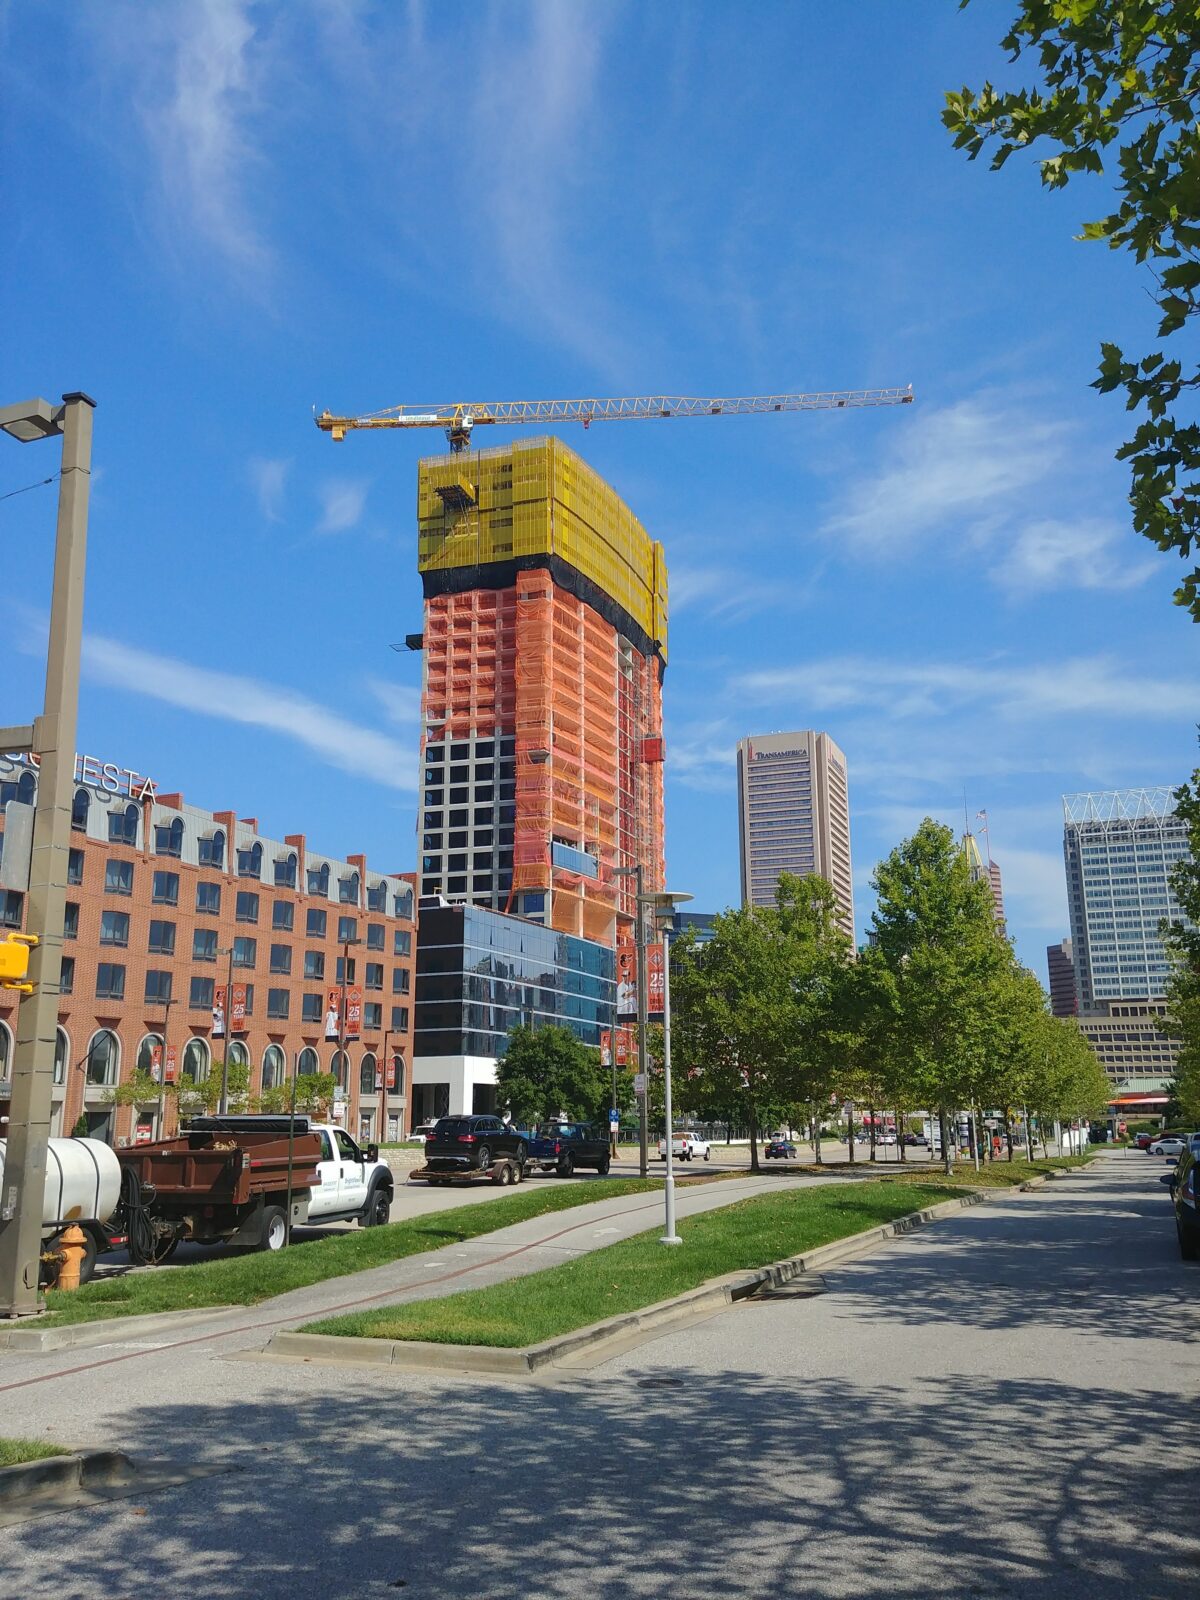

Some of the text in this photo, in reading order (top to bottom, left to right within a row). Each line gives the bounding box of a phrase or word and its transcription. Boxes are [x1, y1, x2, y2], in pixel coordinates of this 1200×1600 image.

[755, 749, 807, 760] TRANSAMERICA
[650, 973, 664, 987] 25
[233, 1003, 245, 1014] 25
[348, 1006, 360, 1017] 25
